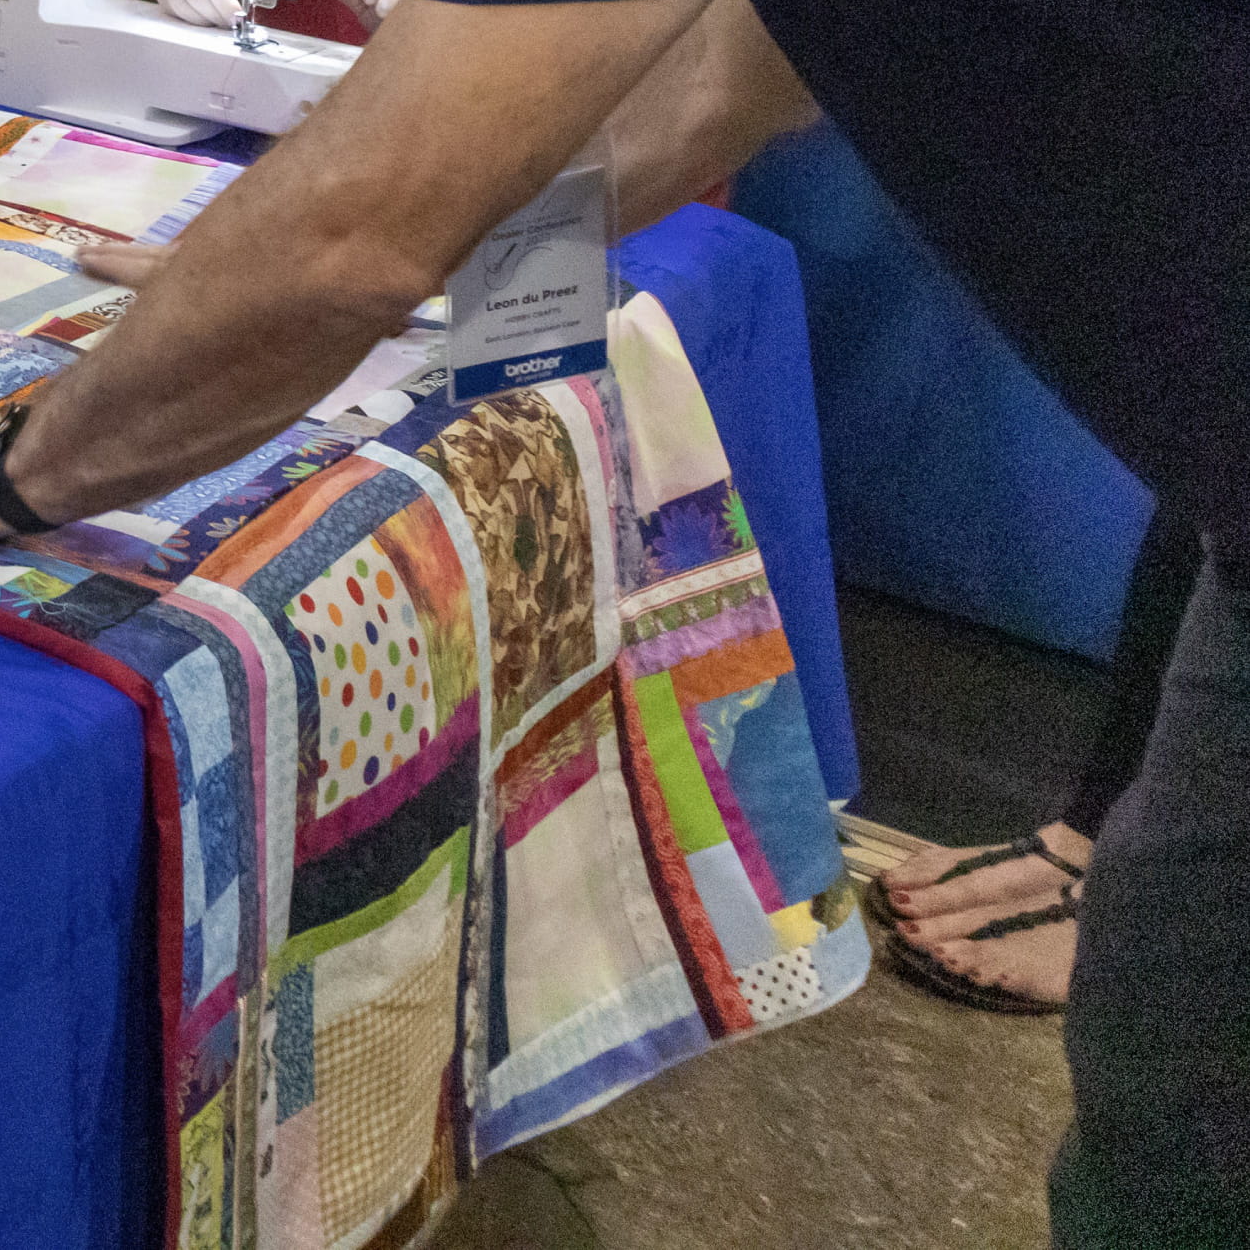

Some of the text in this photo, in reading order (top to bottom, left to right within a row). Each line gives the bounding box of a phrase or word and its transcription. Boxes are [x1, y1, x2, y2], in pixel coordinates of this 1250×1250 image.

[486, 285, 578, 312] Leon du Preez
[504, 354, 563, 378] brother
